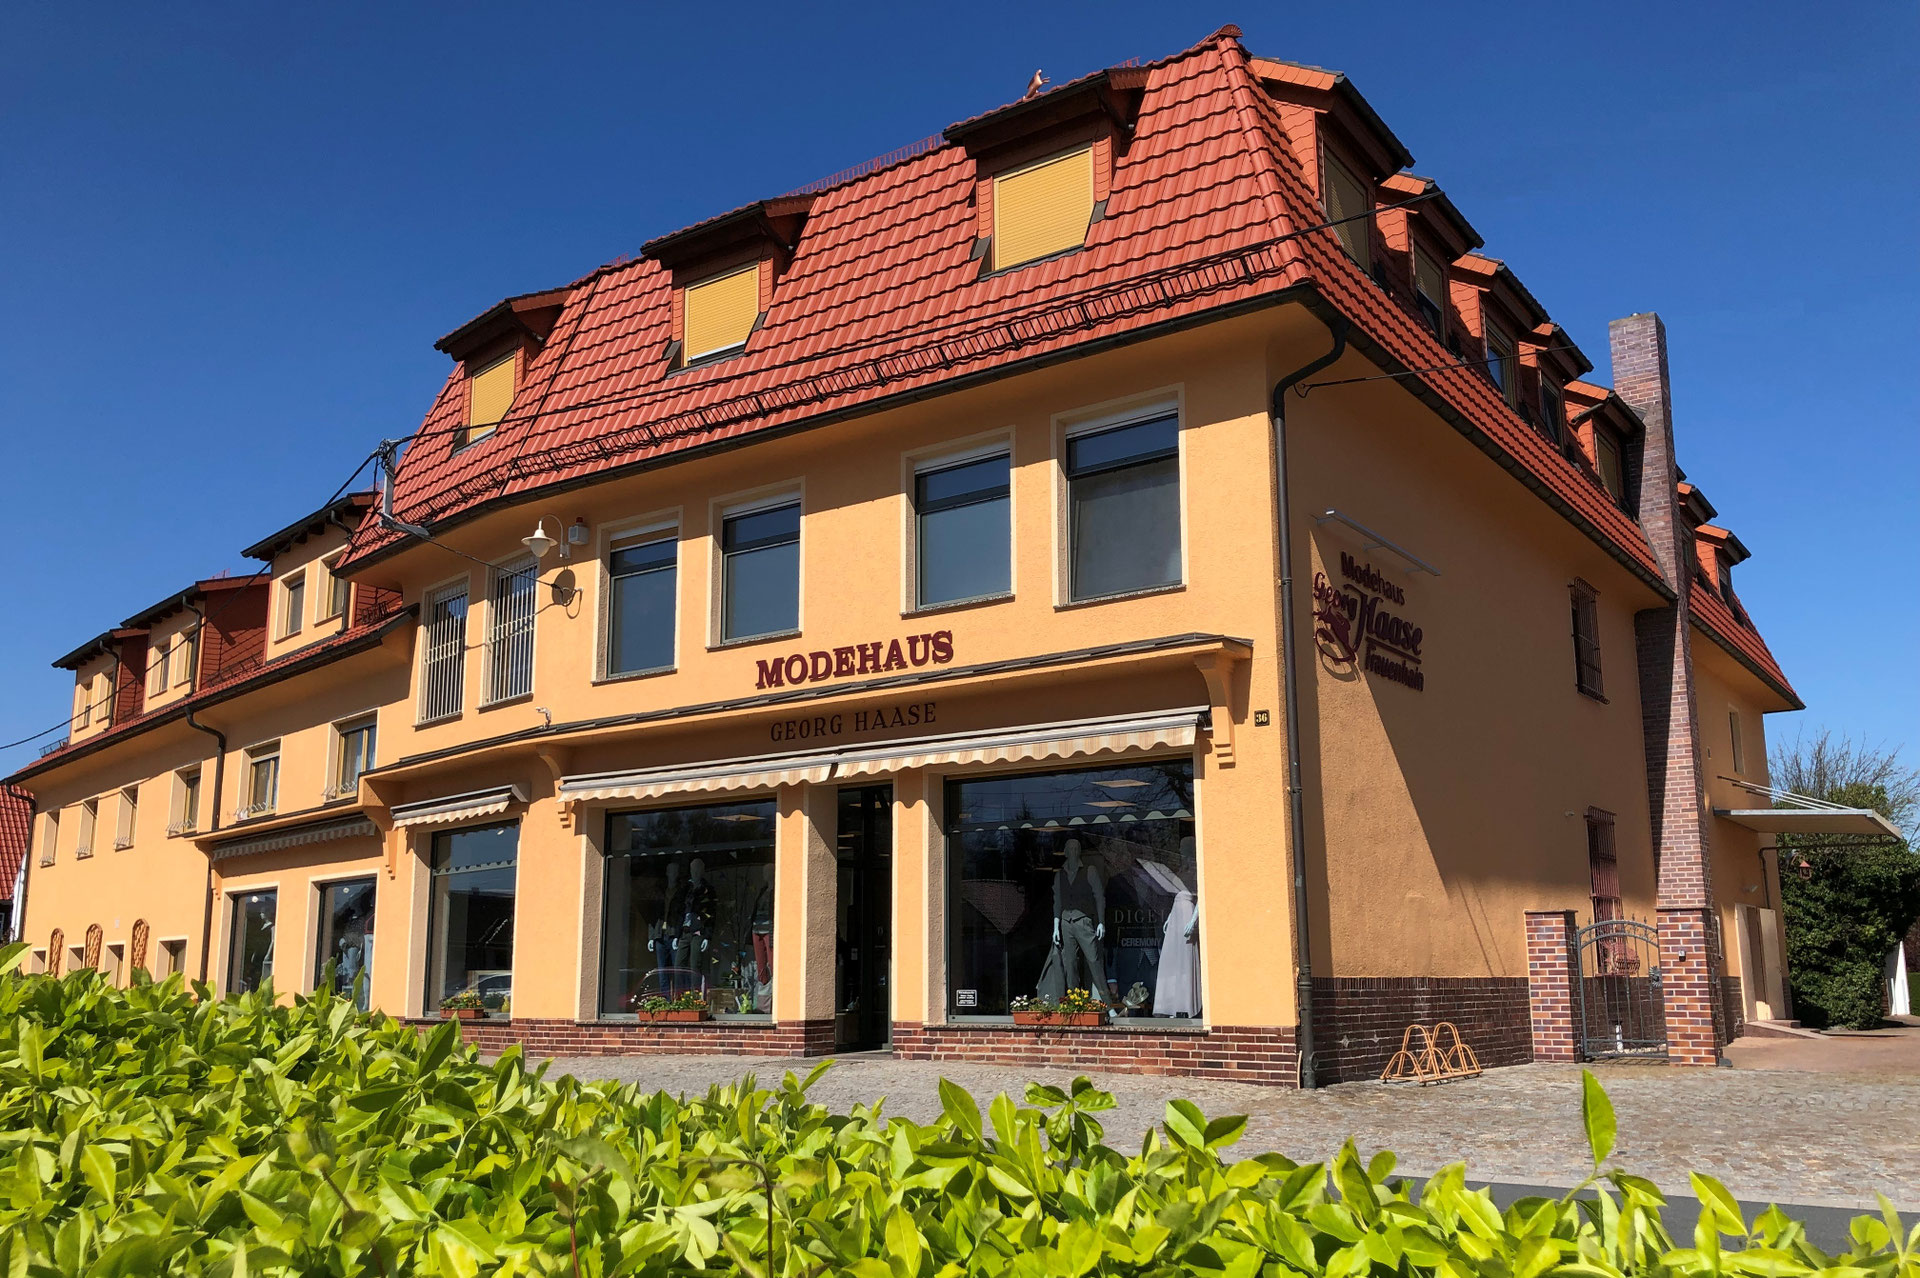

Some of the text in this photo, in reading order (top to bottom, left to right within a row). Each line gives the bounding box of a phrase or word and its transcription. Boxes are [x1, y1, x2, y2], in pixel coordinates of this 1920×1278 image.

[1341, 551, 1405, 606] Modehaus
[1313, 571, 1423, 656] Georg Haase
[755, 630, 954, 690] MODEHAUS
[770, 702, 937, 742] GEORG HAASE
[1256, 713, 1268, 723] 36
